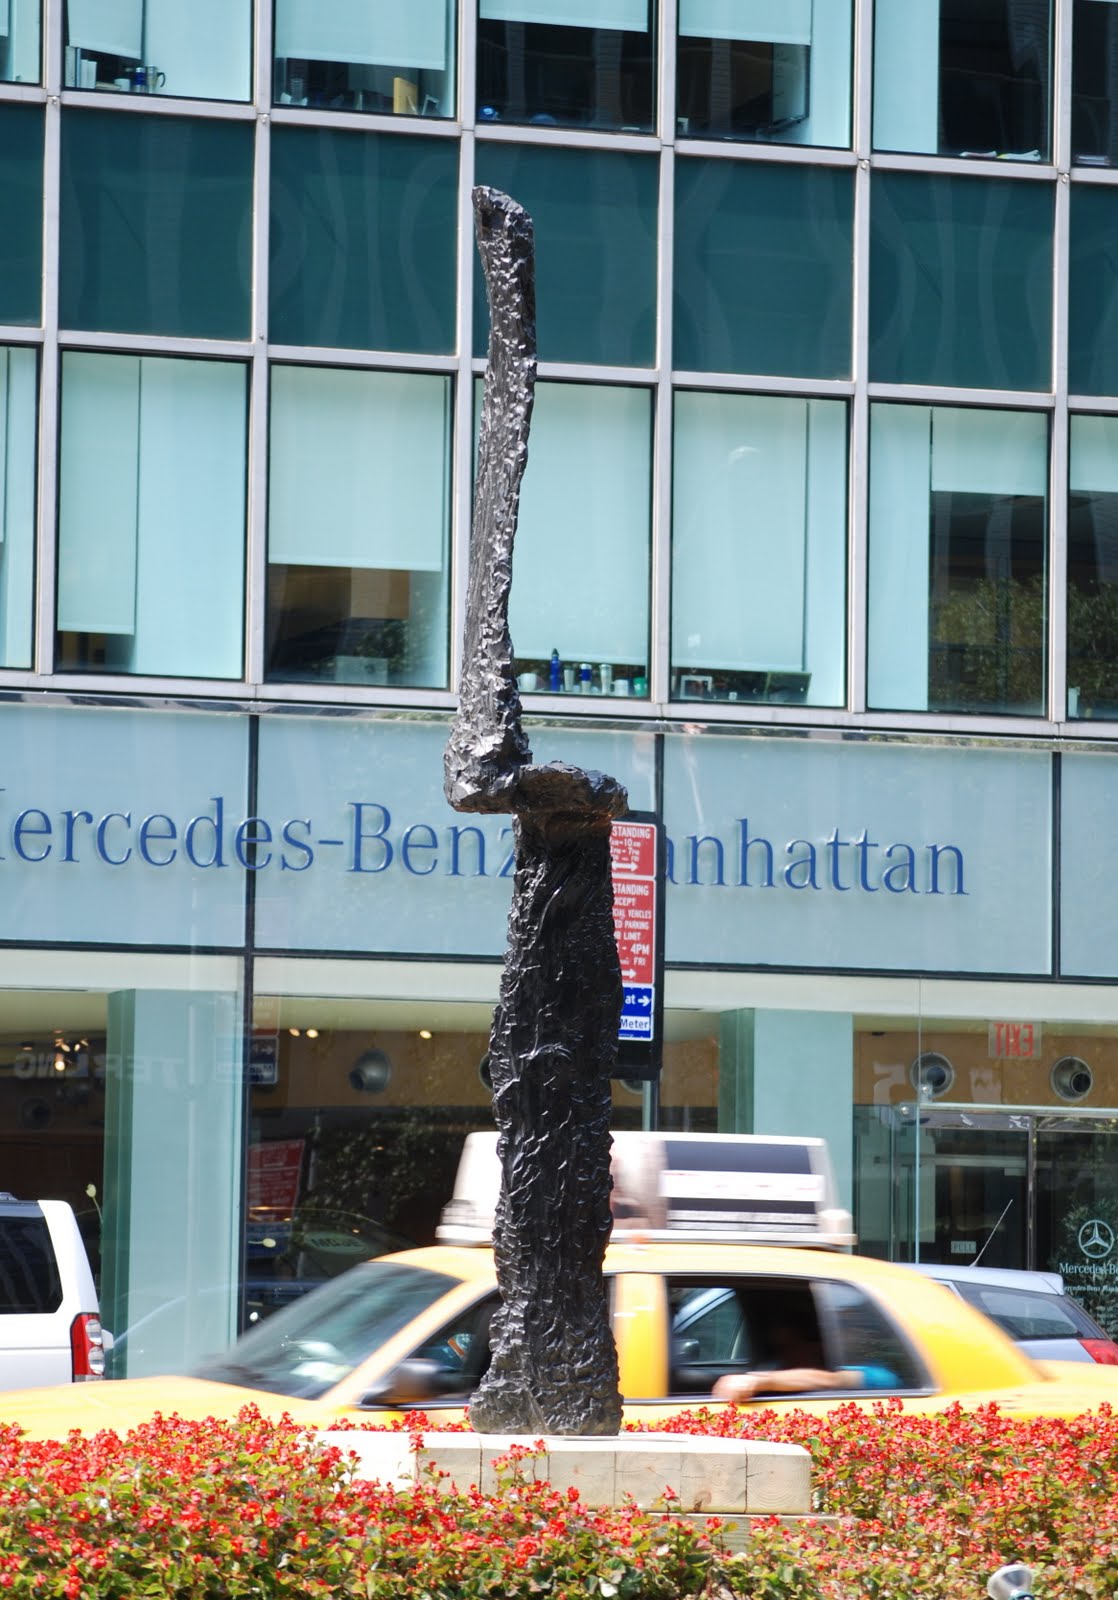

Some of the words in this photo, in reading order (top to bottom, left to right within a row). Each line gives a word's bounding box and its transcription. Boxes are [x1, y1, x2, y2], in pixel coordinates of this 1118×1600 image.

[612, 826, 651, 839] STANDING
[0, 789, 516, 878] ercedes-Benz
[666, 817, 969, 896] nhattan
[612, 882, 650, 896] STANDING
[613, 896, 637, 906] XCEPT
[623, 932, 641, 941] LIMIT
[625, 994, 636, 1005] at
